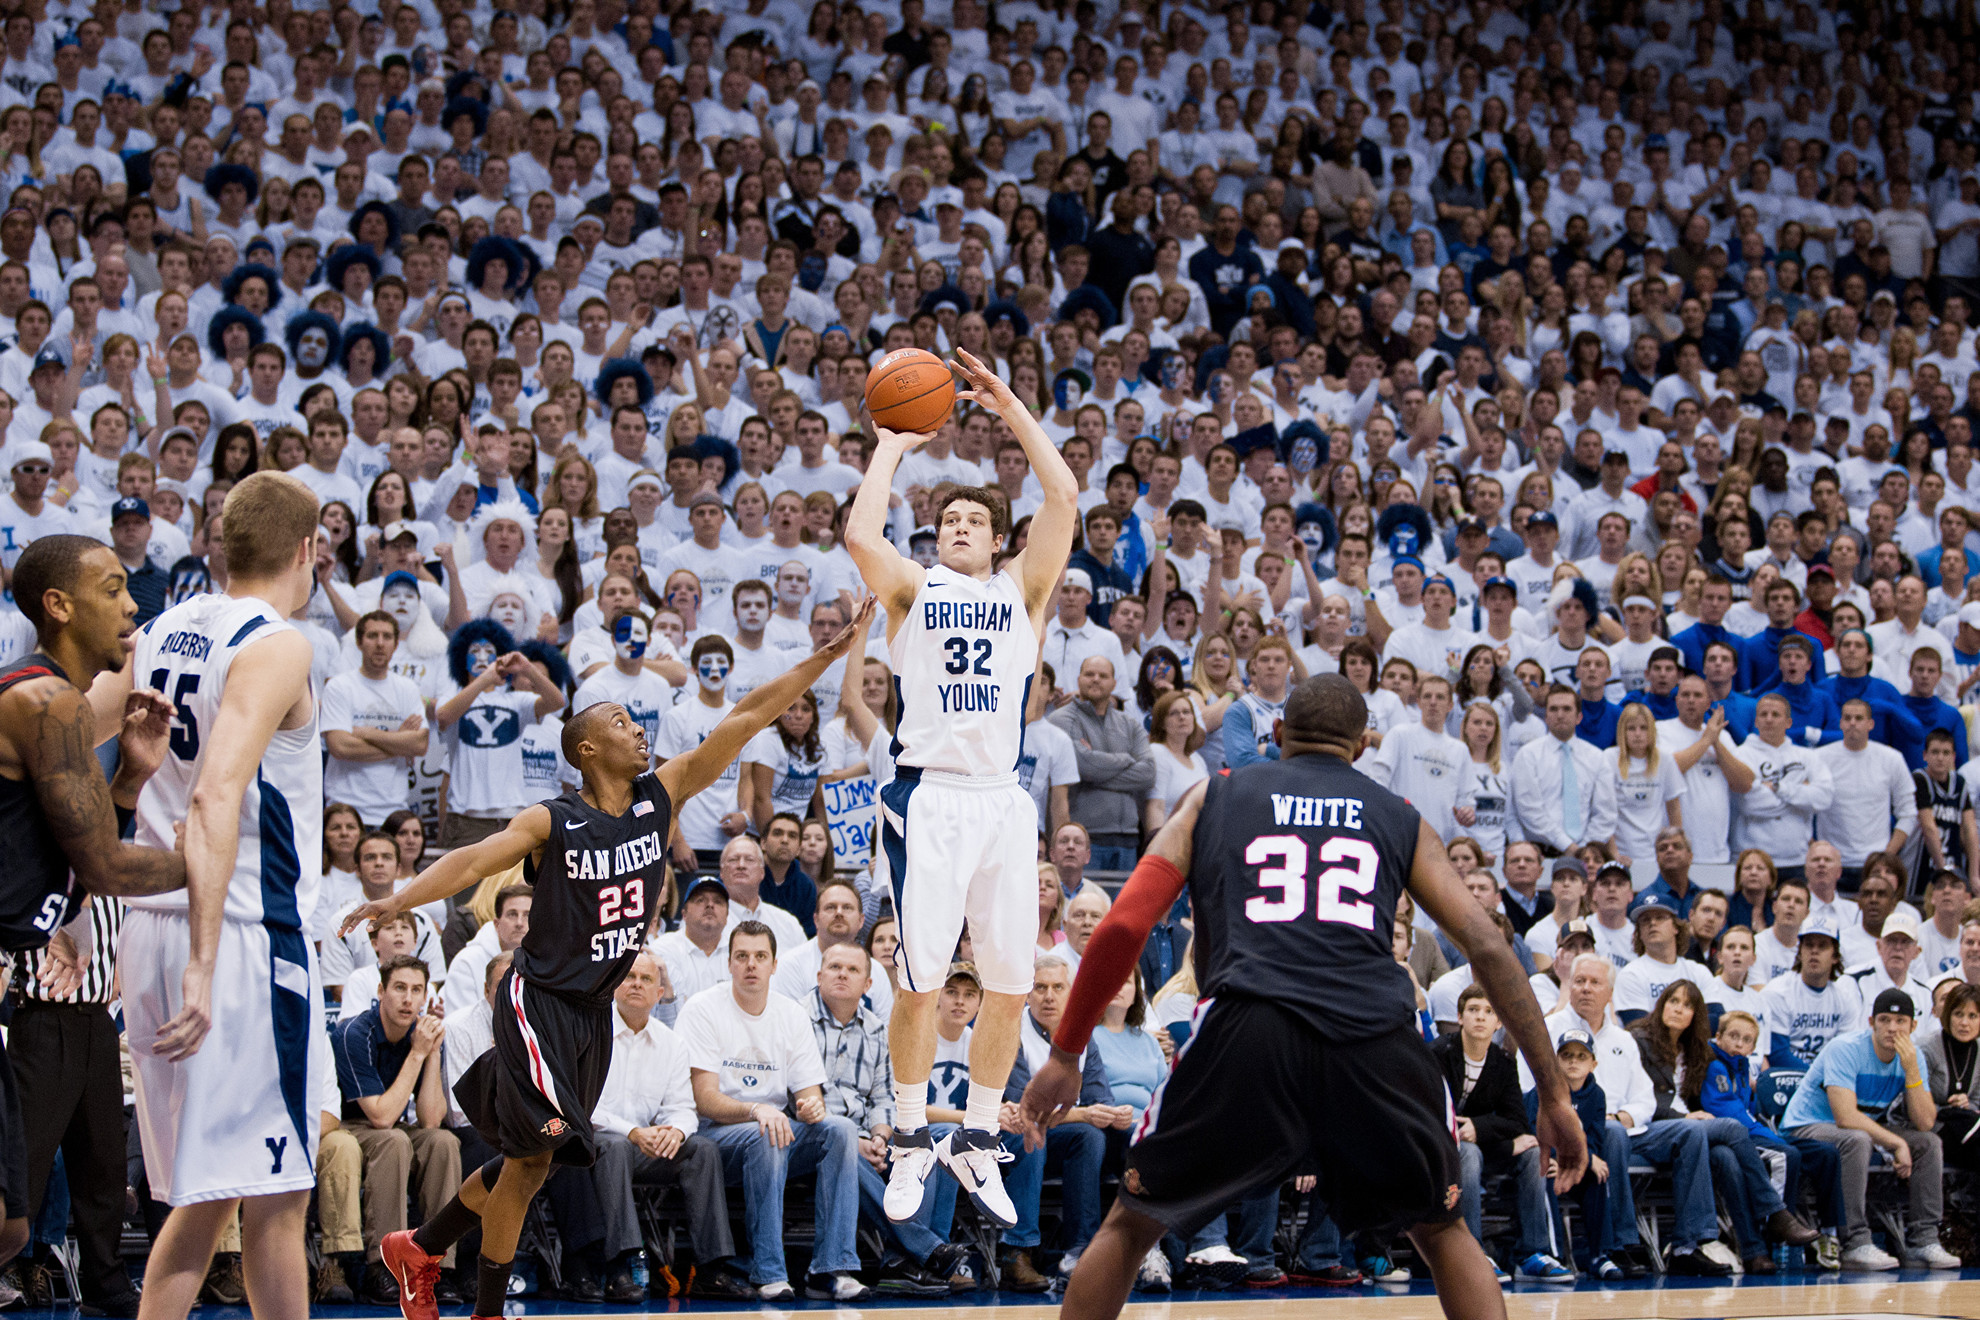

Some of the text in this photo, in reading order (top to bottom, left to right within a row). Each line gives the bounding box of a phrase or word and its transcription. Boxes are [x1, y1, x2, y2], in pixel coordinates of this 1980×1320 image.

[924, 602, 1012, 632] BRIGHAM
[944, 637, 992, 676] 32
[150, 667, 201, 761] 5
[937, 683, 1001, 713] YOUNG
[1271, 793, 1363, 830] WHITE
[565, 831, 662, 880] SAN DIEGO
[598, 878, 645, 926] 23
[1244, 834, 1380, 931] 32
[264, 1136, 287, 1174] Y
